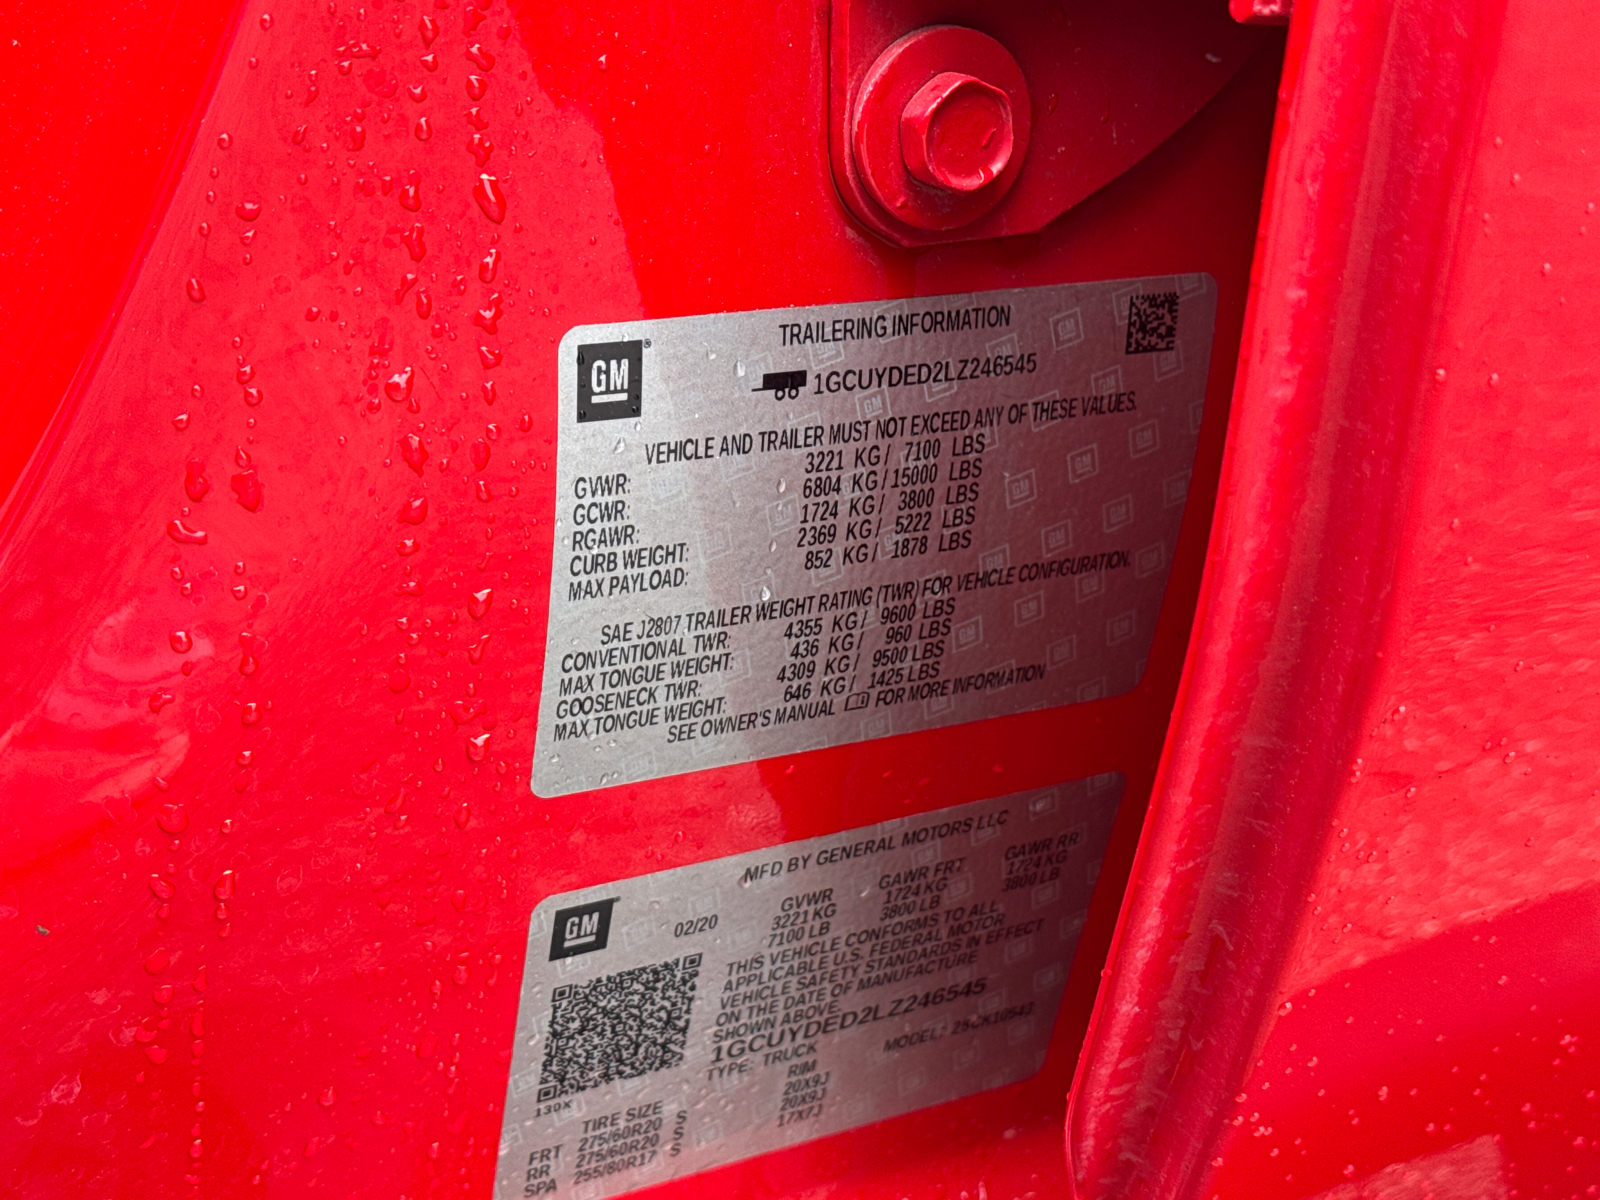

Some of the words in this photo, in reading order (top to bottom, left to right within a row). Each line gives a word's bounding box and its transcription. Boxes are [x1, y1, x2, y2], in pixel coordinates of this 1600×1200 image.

[778, 315, 888, 347] TRAILERING
[891, 304, 1011, 337] INFORMATION
[591, 359, 629, 393] GM
[813, 352, 1037, 395] 1GCUYDED2LZ246545
[574, 472, 631, 500] GVWR:
[804, 449, 844, 474] 3221
[904, 437, 941, 463] 7100
[951, 432, 986, 457] LBS
[645, 436, 715, 465] VEHICLE
[719, 432, 754, 457] AND
[758, 425, 825, 453] TRAILER
[828, 419, 872, 445] MUST
[875, 416, 908, 440] NOT
[909, 409, 971, 437] EXCEED
[972, 405, 1005, 430] ANY
[1007, 402, 1029, 425] OF
[1031, 397, 1079, 423] THESE
[571, 524, 640, 552] RGAWR:
[799, 499, 839, 524] 1724
[897, 487, 935, 512] 3800
[945, 481, 980, 506] LBS
[572, 499, 631, 526] GCWR:
[802, 474, 842, 499] 6804
[948, 457, 983, 482] LBS
[568, 577, 606, 602] MAX
[607, 567, 689, 597] PAYLOAD:
[804, 547, 834, 571] 852
[890, 535, 929, 559] 1878
[937, 529, 972, 553] LBS
[569, 551, 618, 577] CURB
[622, 542, 690, 571] WEIGHT:
[796, 523, 837, 548] 2369
[894, 510, 932, 535] 5222
[941, 505, 976, 529] LBS
[600, 621, 634, 646] SAE
[636, 614, 682, 640] J2807
[685, 604, 752, 632] TRAILER
[755, 595, 816, 622] WEIGHT
[817, 586, 874, 613] RATING
[875, 579, 920, 611] (TWR)
[921, 575, 953, 598] FOR
[957, 566, 1017, 592] VEHICLE
[1017, 549, 1131, 584] CONFIGURATION.
[558, 673, 596, 697] MAX
[599, 662, 667, 690] TONGUE
[670, 651, 735, 680] WEIGHT:
[789, 638, 820, 660] 436
[884, 623, 913, 646] 960
[917, 617, 952, 641] LBS
[561, 637, 687, 674] CONVENTIONAL
[693, 630, 732, 654] TWR:
[783, 617, 823, 641] 4355
[880, 602, 917, 626] 9600
[922, 596, 956, 620] LBS
[553, 718, 590, 742] MAX
[593, 707, 661, 736] TONGUE
[664, 696, 727, 724] WEIGHT:
[783, 681, 812, 703] 646
[867, 666, 905, 690] 1425
[907, 660, 941, 683] LBS
[556, 685, 659, 720] GOOSENECK
[664, 679, 702, 702] TWR:
[776, 659, 817, 684] 4309
[872, 645, 909, 668] 9500
[911, 639, 946, 662] LBS
[667, 721, 698, 744] SEE
[700, 708, 772, 738] OWNER'S
[773, 698, 836, 725] MANUAL
[874, 687, 906, 708] FOR
[907, 679, 951, 701] MORE
[952, 663, 1047, 695] INFORMATION
[742, 861, 783, 883] MFD
[786, 853, 812, 873] BY
[815, 835, 896, 866] GENERAL
[901, 817, 974, 847] MOTORS
[975, 809, 1009, 831] LLC
[780, 887, 834, 913] GVWR
[878, 865, 930, 890] GAWR
[933, 856, 967, 878] FRT
[1004, 837, 1054, 862] GAWR
[1055, 831, 1080, 850] RR
[563, 913, 599, 940] GM
[673, 914, 719, 938] 02/20
[767, 926, 806, 948] 7100
[808, 920, 831, 939] LB
[879, 900, 917, 922] 3800
[919, 894, 942, 913] LB
[1001, 871, 1038, 892] 3800
[1039, 866, 1061, 884] LB
[771, 909, 809, 931] 3221
[811, 902, 837, 922] KG
[883, 882, 922, 905] 1724
[923, 876, 949, 895] KG
[1006, 855, 1043, 876] 1724
[1043, 848, 1068, 867] KG
[720, 980, 792, 1010] VEHICLE
[795, 964, 860, 992] SAFETY
[864, 937, 963, 974] STANDARDS
[965, 934, 982, 949] IN
[985, 918, 1045, 945] EFFECT
[722, 955, 829, 994] APPLICABLE
[832, 947, 865, 967] U.S.
[869, 928, 943, 958] FEDERAL
[946, 913, 1006, 939] MOTOR
[727, 954, 765, 977] THIS
[769, 936, 841, 966] VEHICLE
[844, 912, 940, 948] CONFORMS
[944, 906, 966, 924] TO
[967, 900, 998, 918] ALL
[711, 977, 988, 1065] 1GCUYDED2LZ246545
[715, 1008, 742, 1027] ON
[747, 999, 779, 1020] THE
[783, 987, 827, 1011] DATE
[830, 980, 854, 998] OF
[856, 949, 978, 992] MANUFACTURE
[706, 1057, 755, 1082] TYPE:
[763, 1040, 818, 1066] TRUCK
[712, 1015, 777, 1044] SHOWN
[528, 1143, 564, 1166] FRT
[577, 1116, 663, 1153] 275/60R20
[783, 1071, 830, 1096] 20X9J
[534, 1099, 573, 1119] 130X
[582, 1111, 621, 1134] TIRE
[624, 1100, 663, 1123] SIZE
[787, 1058, 818, 1079] RIM
[524, 1178, 558, 1198] SPA
[525, 1163, 551, 1183] RR
